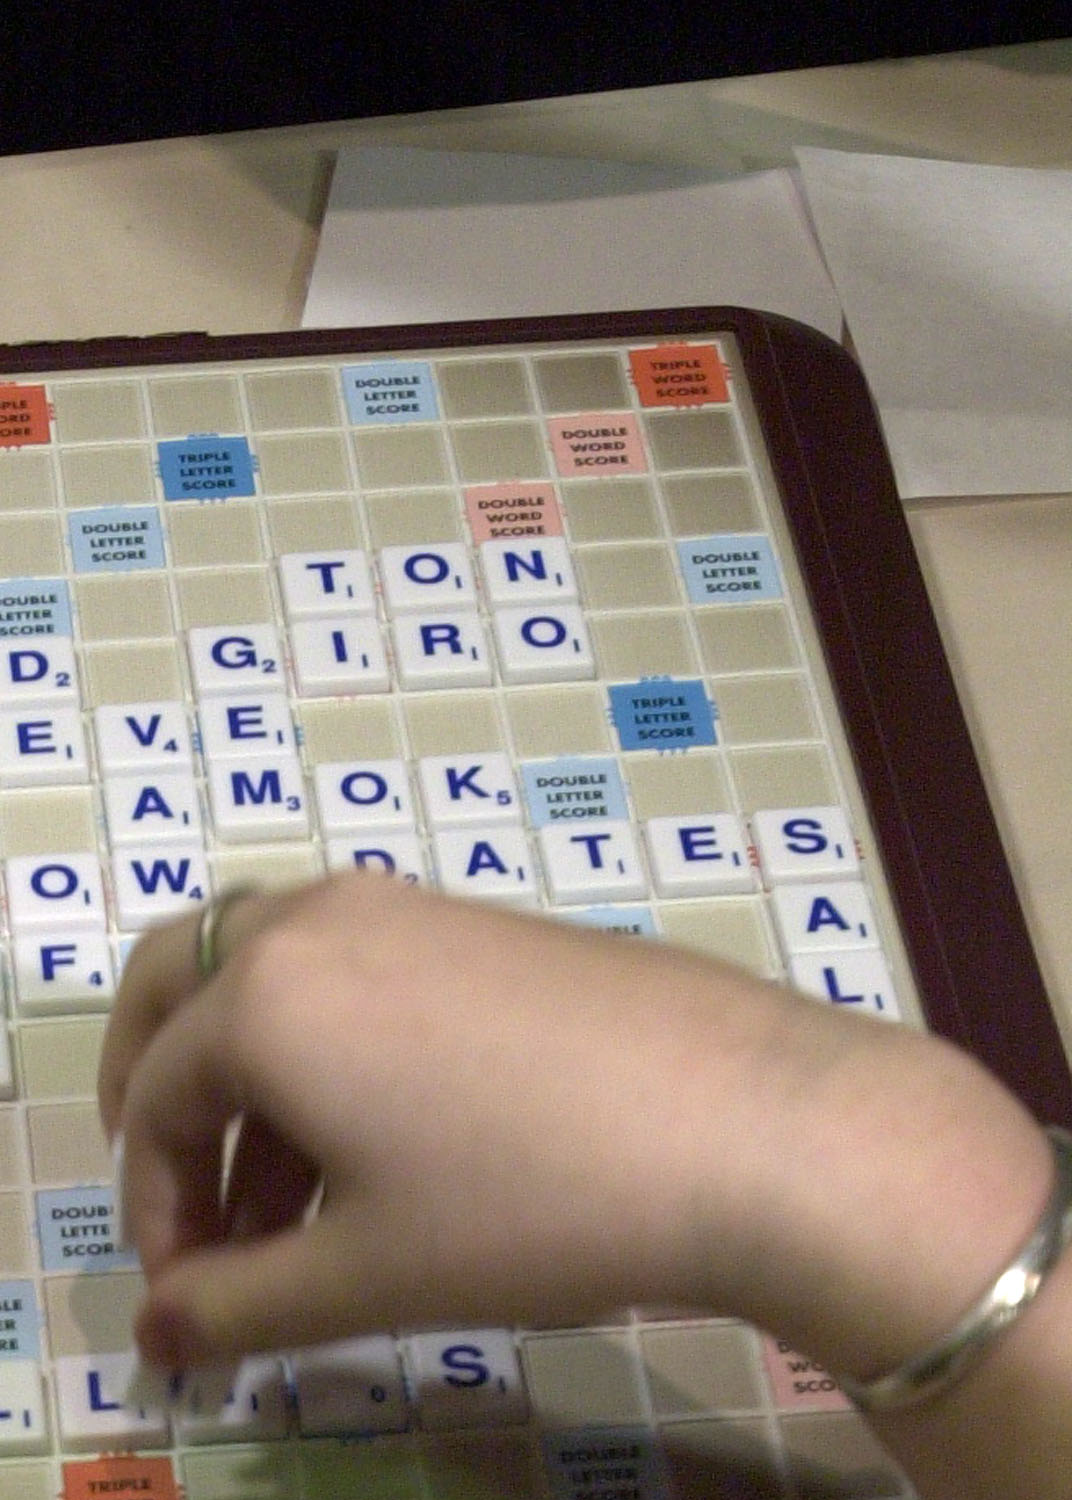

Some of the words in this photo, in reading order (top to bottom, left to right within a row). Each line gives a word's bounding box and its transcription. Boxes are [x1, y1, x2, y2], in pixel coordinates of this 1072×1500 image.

[649, 359, 702, 371] TRIPLE
[354, 376, 421, 389] DOUBLE
[651, 372, 707, 385] WORD
[363, 389, 417, 402] LETTER
[655, 386, 710, 398] SCORE
[366, 403, 420, 415] SCORE
[561, 427, 628, 440] DOUBLE
[569, 441, 626, 453] WORD
[178, 451, 231, 464] TRIPLE
[573, 455, 629, 467] SCORE
[179, 465, 234, 478] LETTER
[181, 478, 236, 491] SCORE
[477, 497, 545, 510] DOUBLE
[486, 511, 543, 523] WORD
[81, 521, 149, 535] DOUBLE
[490, 525, 545, 538] SCORE
[89, 535, 144, 548] LETTER
[91, 549, 146, 563] SCORE
[691, 550, 760, 565] DOUBLE
[702, 566, 757, 579] LETTER
[705, 580, 762, 594] SCORE
[631, 696, 686, 709] TRIPLE
[634, 711, 691, 725] LETTER
[637, 726, 695, 740] SCORE
[536, 774, 607, 788] DOUBLE
[546, 790, 604, 803] LETTER
[549, 805, 608, 821] SCORE
[51, 1205, 114, 1220] DOUB
[60, 1224, 110, 1238] LETTE
[62, 1243, 115, 1257] SCOR
[793, 1379, 837, 1393] SCO
[86, 1476, 152, 1494] TRIPLE
